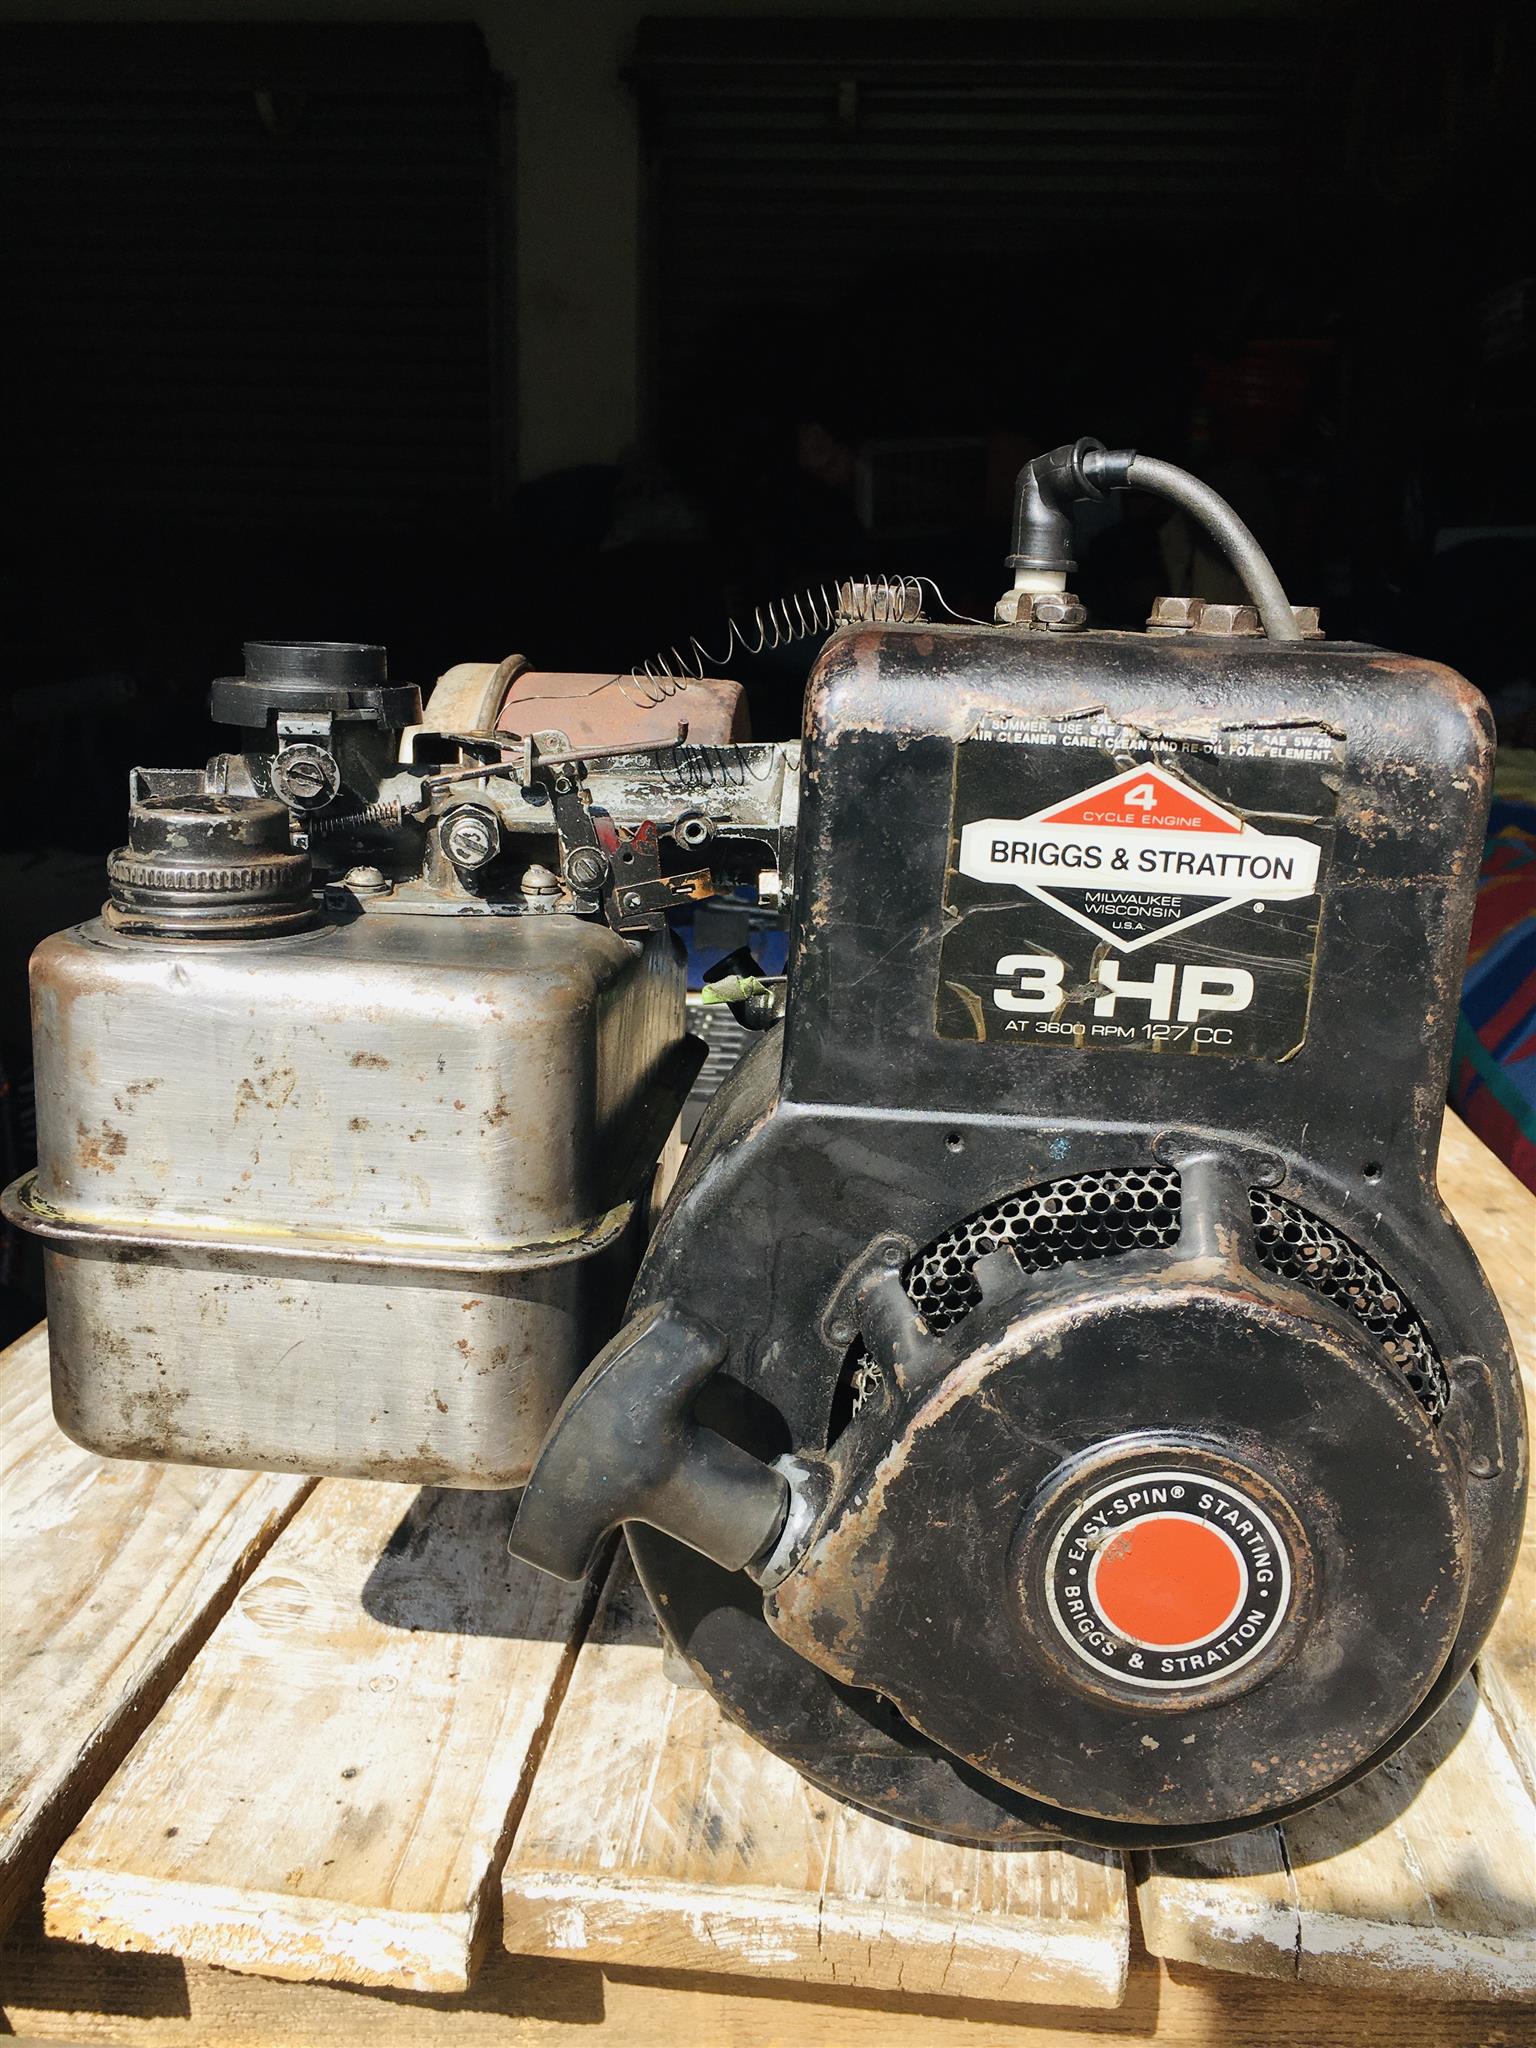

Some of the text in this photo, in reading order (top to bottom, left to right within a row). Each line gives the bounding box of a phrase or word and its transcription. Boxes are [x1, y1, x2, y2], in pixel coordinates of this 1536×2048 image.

[1058, 722, 1083, 735] USE
[1090, 724, 1115, 737] SAE
[996, 731, 1057, 745] CLEANER
[1062, 735, 1102, 748] CARE:
[1105, 738, 1147, 751] CLEAN
[1150, 740, 1178, 752] AND
[1181, 742, 1225, 755] RE-OIL
[1229, 744, 1265, 757] FOA
[1270, 747, 1334, 761] ELEMENT.
[1124, 783, 1158, 811] 4
[1083, 811, 1202, 827] CYCLE ENGINE
[990, 840, 1294, 880] BRIGGS & STRATTON
[1084, 904, 1181, 919] WISCONSIN
[1085, 891, 1182, 907] MILWAUKEE
[1112, 921, 1146, 931] U.S.A.
[993, 954, 1255, 1023] 3 HP
[1004, 1020, 1233, 1045] AT 3600 RPM 127 CC
[1198, 1493, 1274, 1584] STARTING
[1064, 1585, 1266, 1673] BRIGGS & STRATTON
